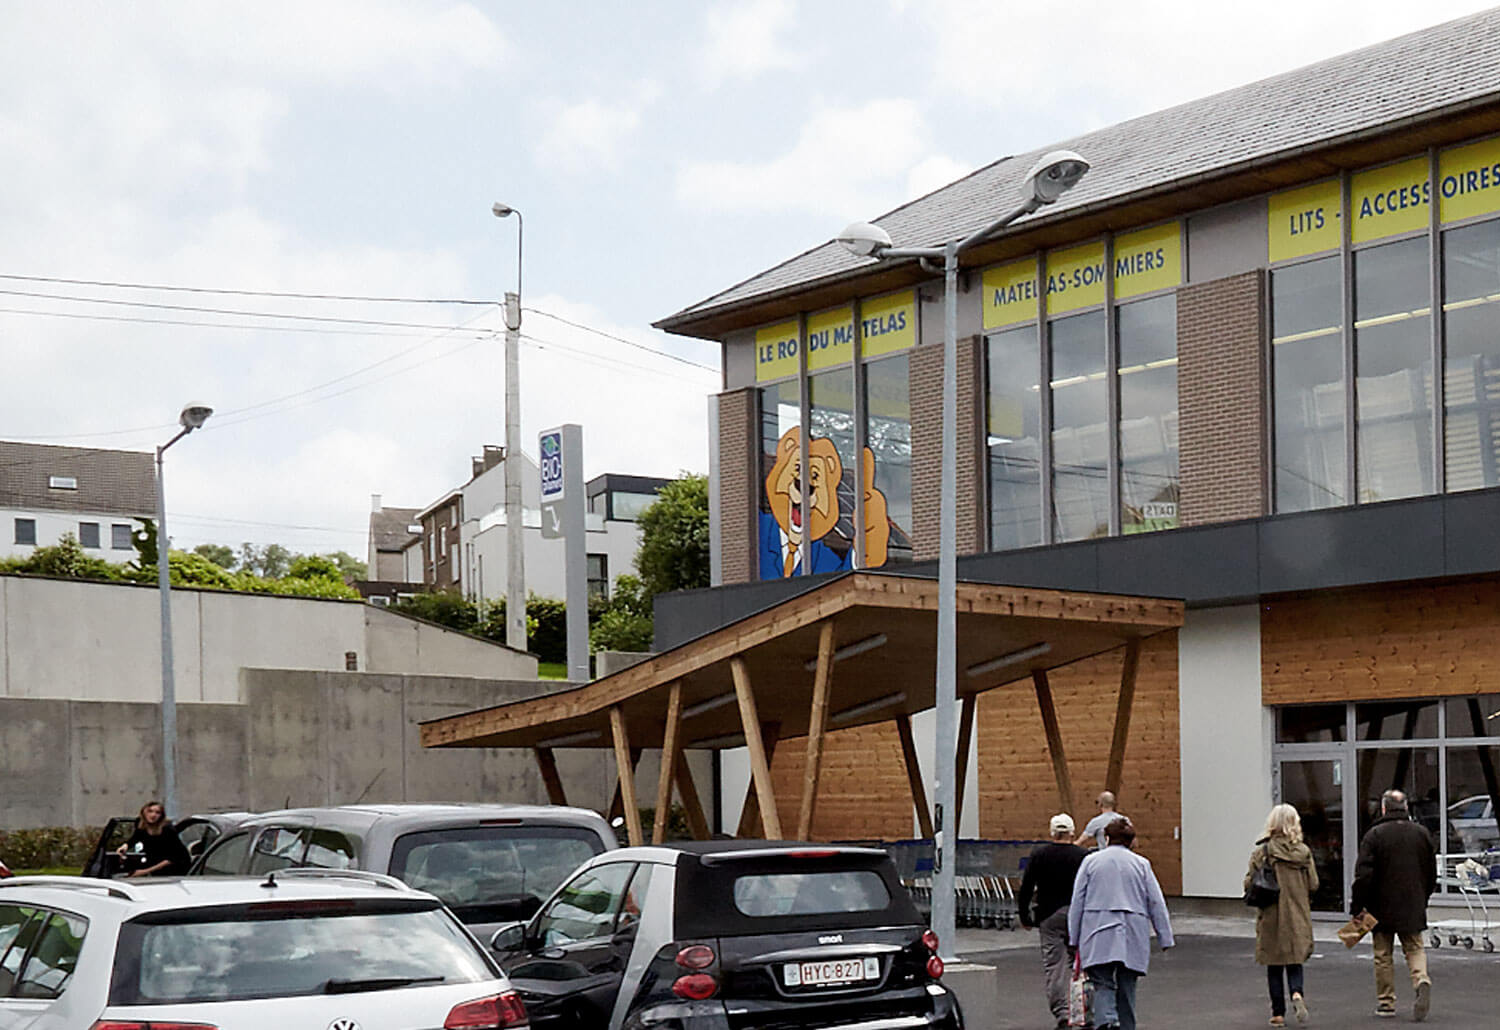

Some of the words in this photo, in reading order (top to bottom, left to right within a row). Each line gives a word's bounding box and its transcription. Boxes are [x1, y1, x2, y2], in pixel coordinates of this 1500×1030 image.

[1290, 207, 1325, 236] LITS
[760, 345, 774, 363] LE
[778, 338, 798, 360] RO
[810, 330, 829, 352] DU
